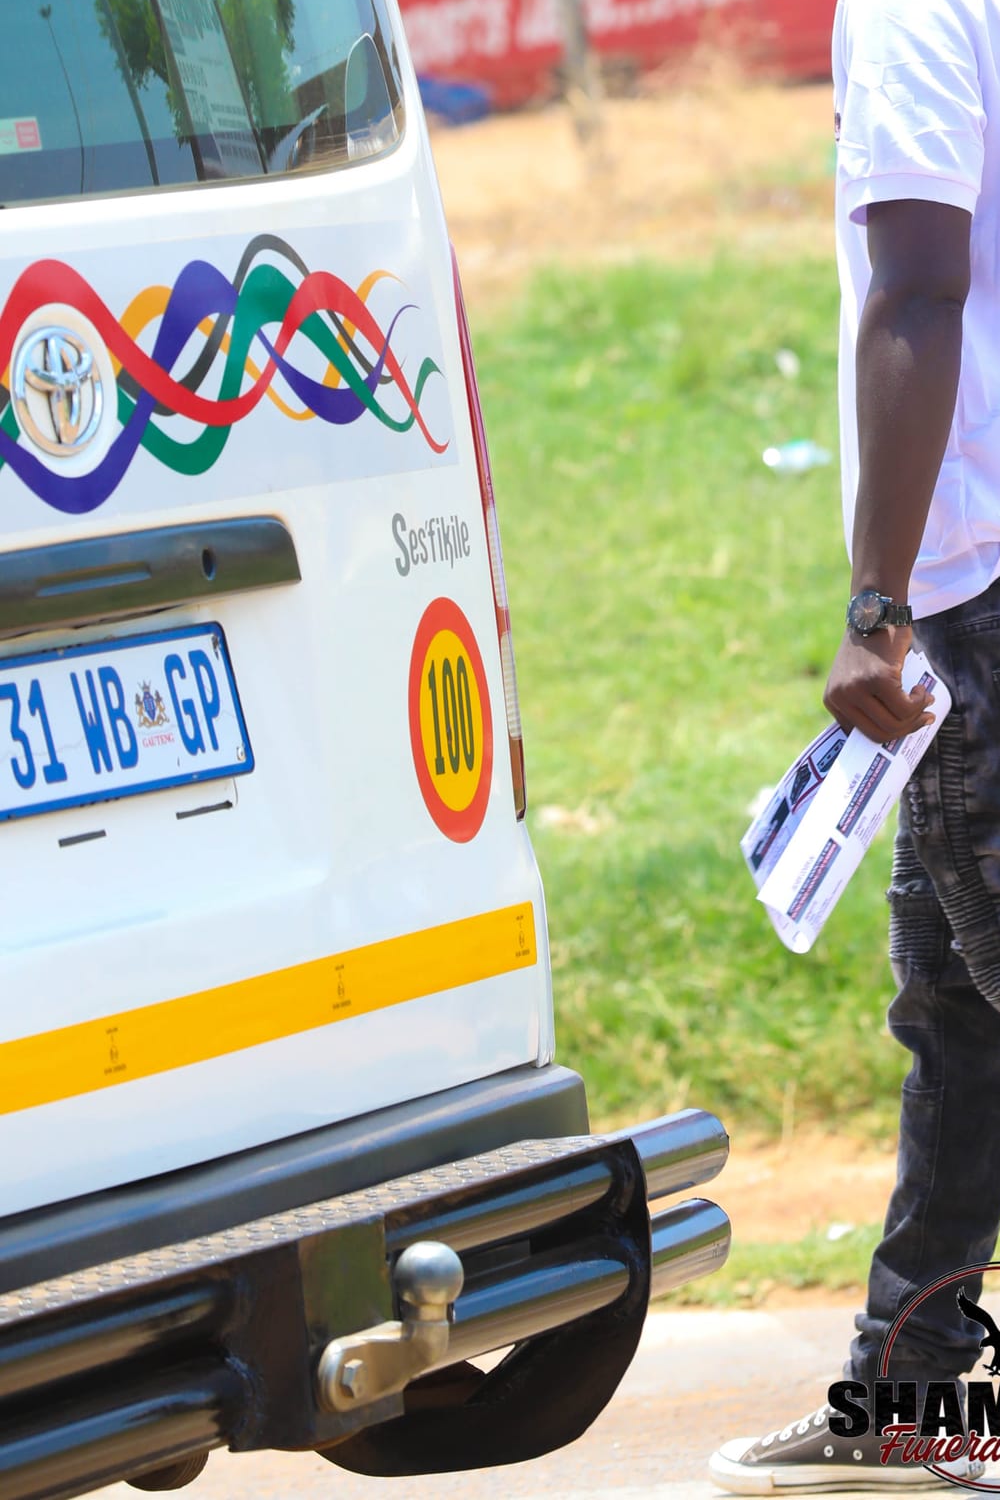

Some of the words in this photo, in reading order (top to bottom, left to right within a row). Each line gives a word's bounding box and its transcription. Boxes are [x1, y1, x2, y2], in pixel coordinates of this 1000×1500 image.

[70, 665, 139, 776] WB
[164, 649, 220, 757] GP
[142, 733, 175, 749] GAUTENG
[428, 655, 475, 775] 100
